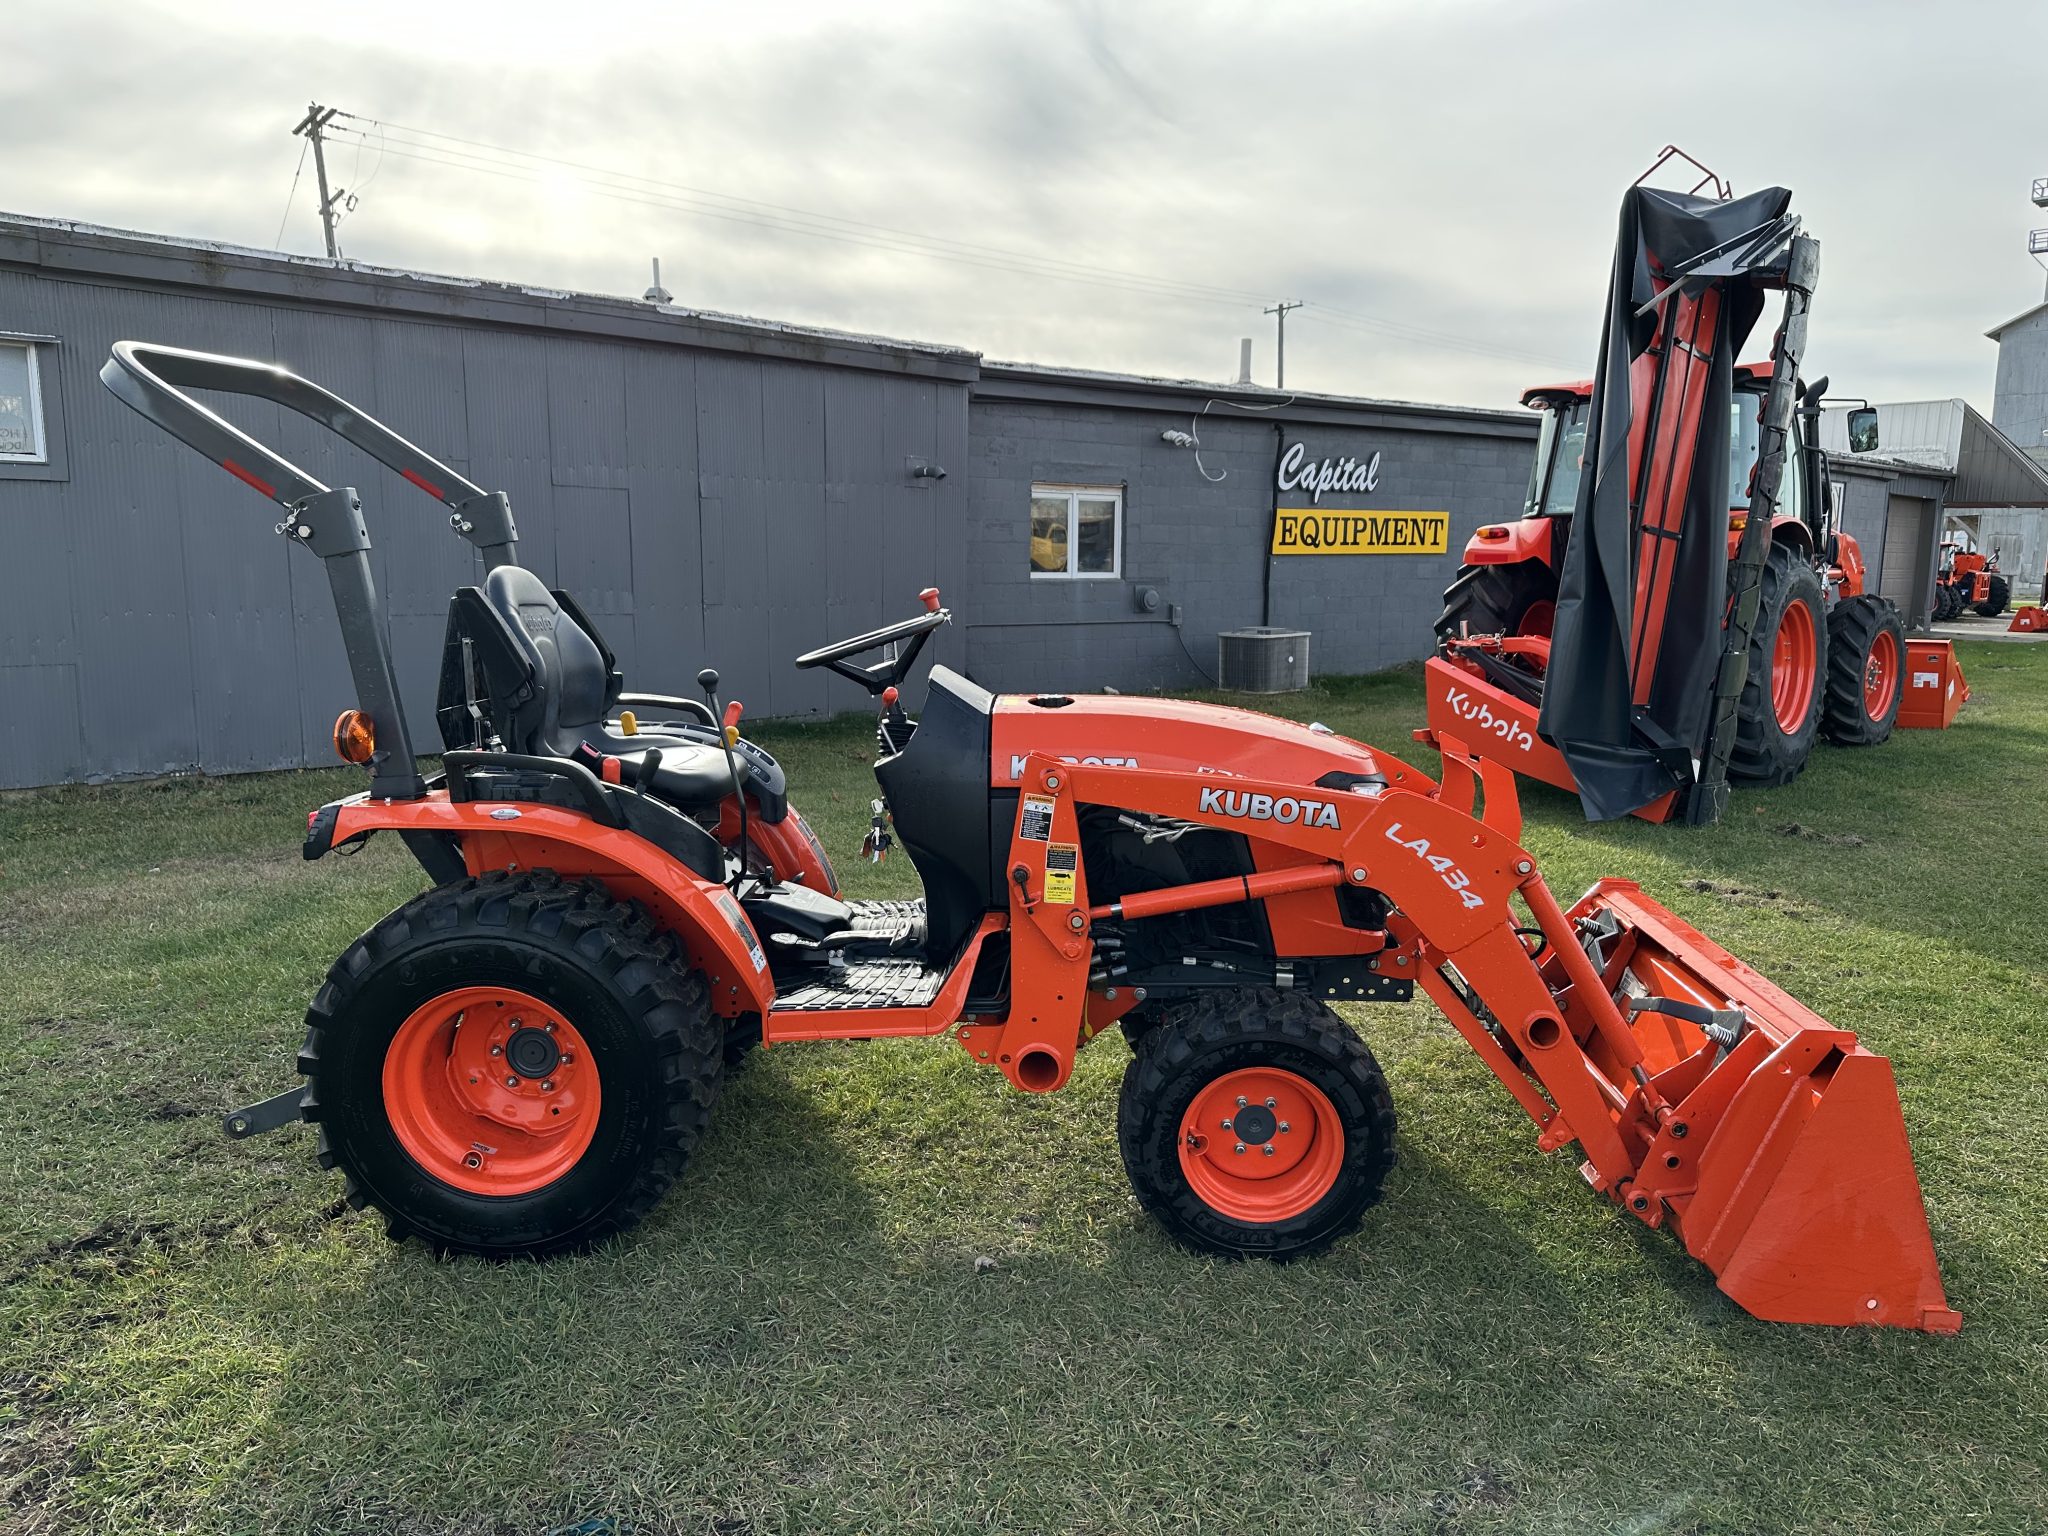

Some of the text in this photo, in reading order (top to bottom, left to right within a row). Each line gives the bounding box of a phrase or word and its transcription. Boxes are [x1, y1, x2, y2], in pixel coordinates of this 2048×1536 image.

[1278, 442, 1380, 504] Capital
[1278, 516, 1444, 548] EQUIPMENT
[1445, 687, 1533, 752] Kubota
[1198, 786, 1342, 831] KUBOTA
[1385, 823, 1485, 910] LA434
